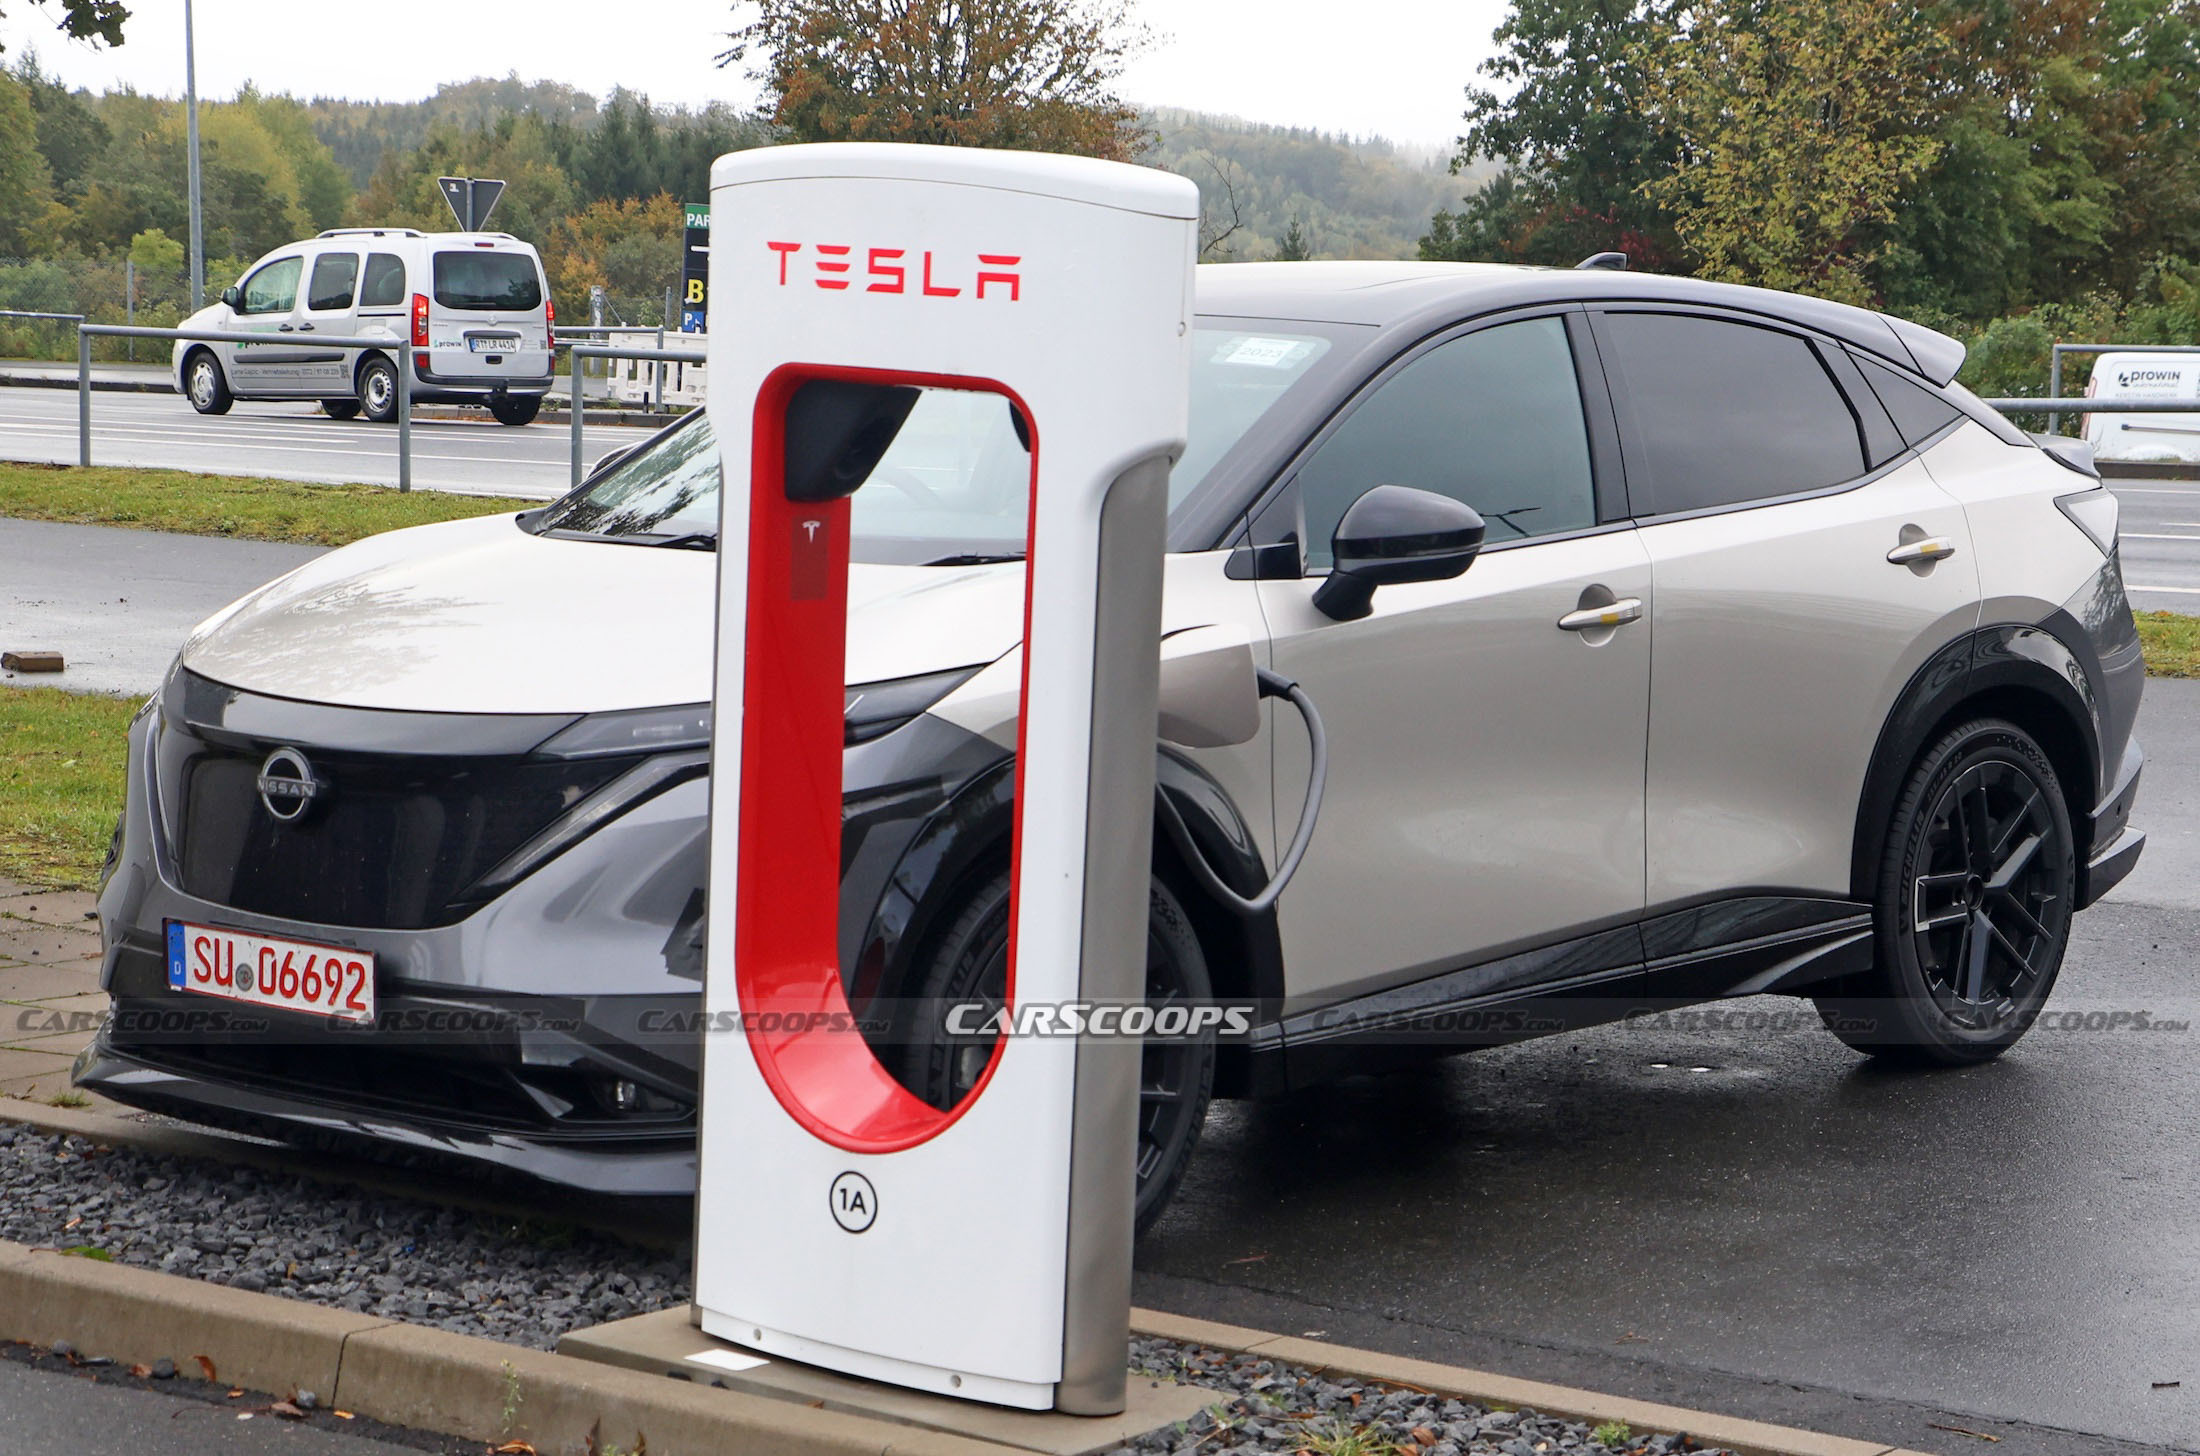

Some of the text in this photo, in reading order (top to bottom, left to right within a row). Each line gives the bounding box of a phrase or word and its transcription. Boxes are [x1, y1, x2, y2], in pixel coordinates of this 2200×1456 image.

[767, 241, 1022, 302] TESLA
[258, 779, 314, 797] NISSAN
[174, 960, 181, 975] D
[193, 936, 367, 1012] SU 06692
[840, 1188, 866, 1215] 1A
